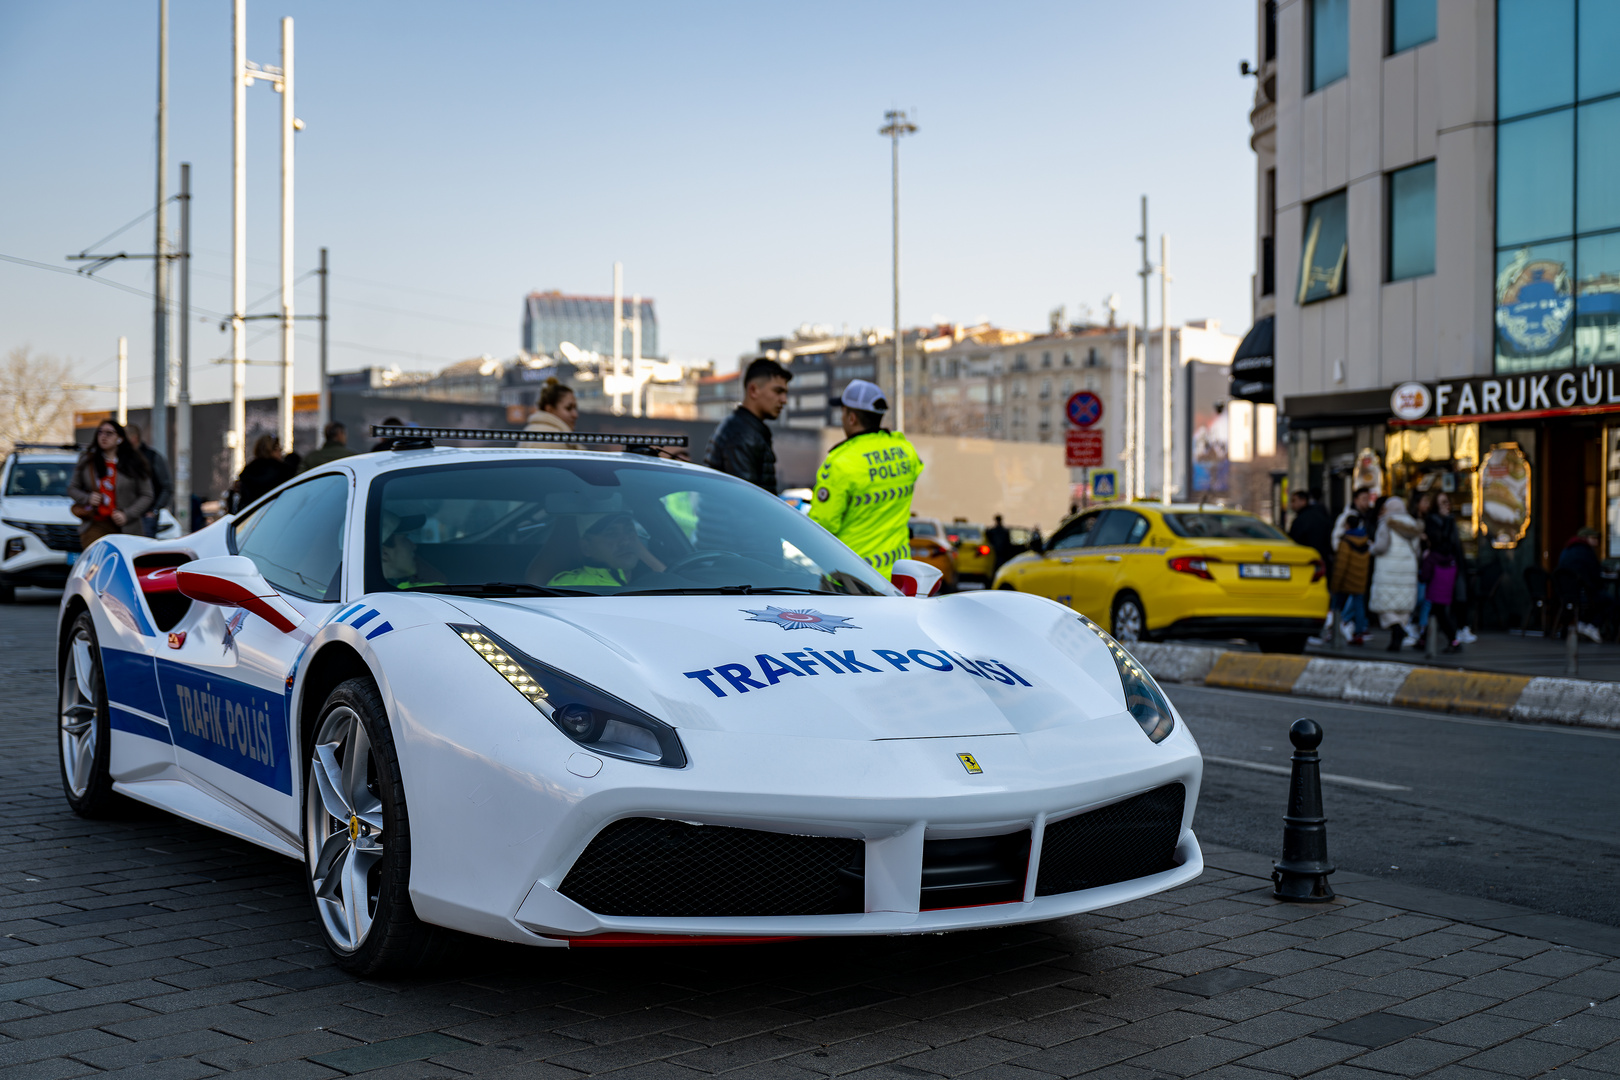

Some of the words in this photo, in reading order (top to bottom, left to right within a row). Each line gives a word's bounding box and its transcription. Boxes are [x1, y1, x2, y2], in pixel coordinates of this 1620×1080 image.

[683, 647, 884, 698] TRAFİK
[871, 649, 1033, 688] POLİSİ
[176, 682, 226, 747] TRAFİK
[225, 697, 275, 768] POLİSİ
